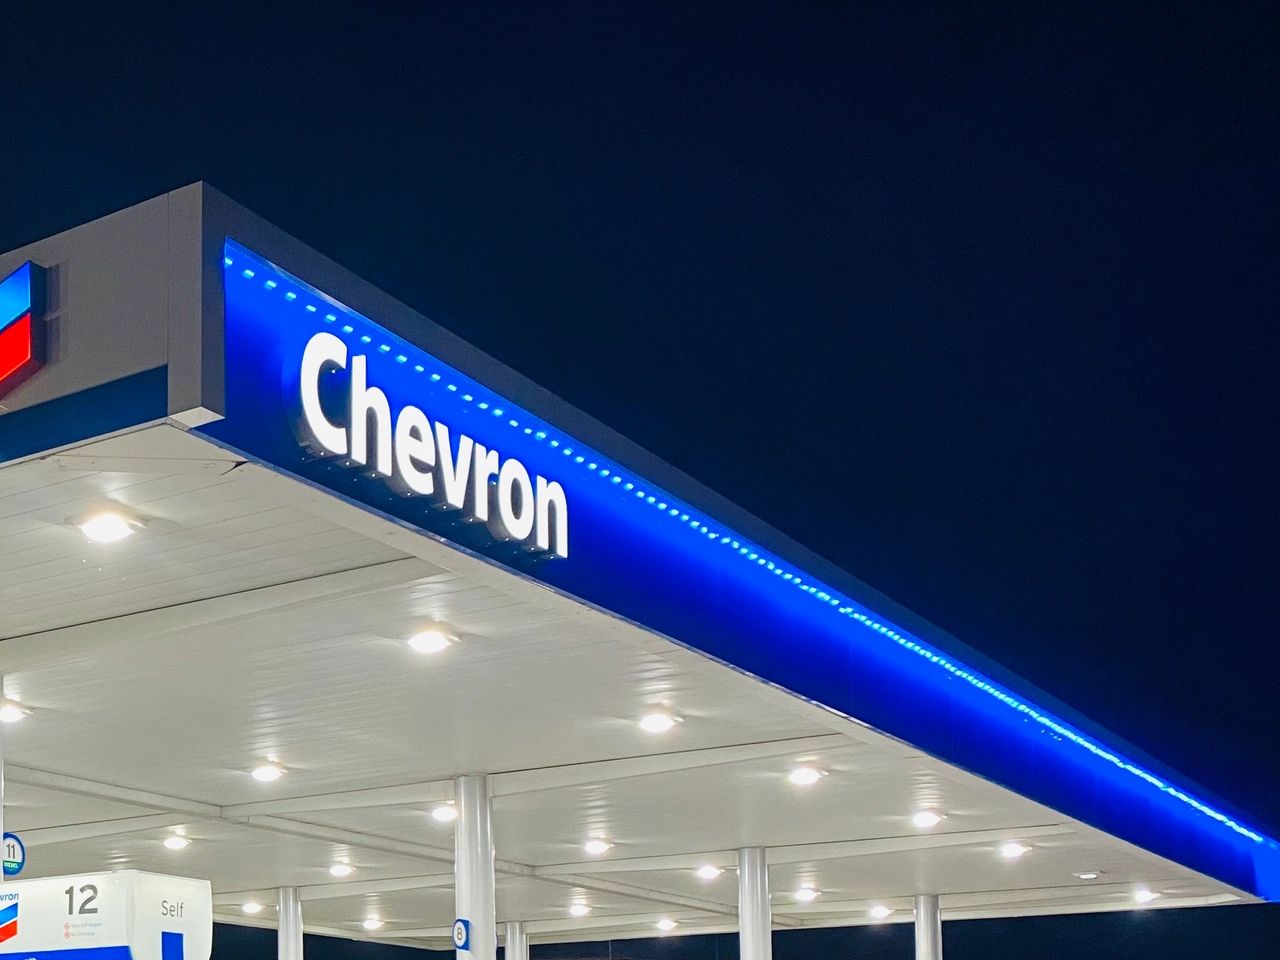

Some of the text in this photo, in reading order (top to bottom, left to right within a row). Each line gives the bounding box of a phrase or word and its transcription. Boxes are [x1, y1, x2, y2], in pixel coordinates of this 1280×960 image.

[300, 332, 568, 558] Chevron
[6, 844, 16, 859] 11
[65, 884, 99, 915] 12
[161, 900, 184, 918] Self
[457, 927, 462, 940] 8
